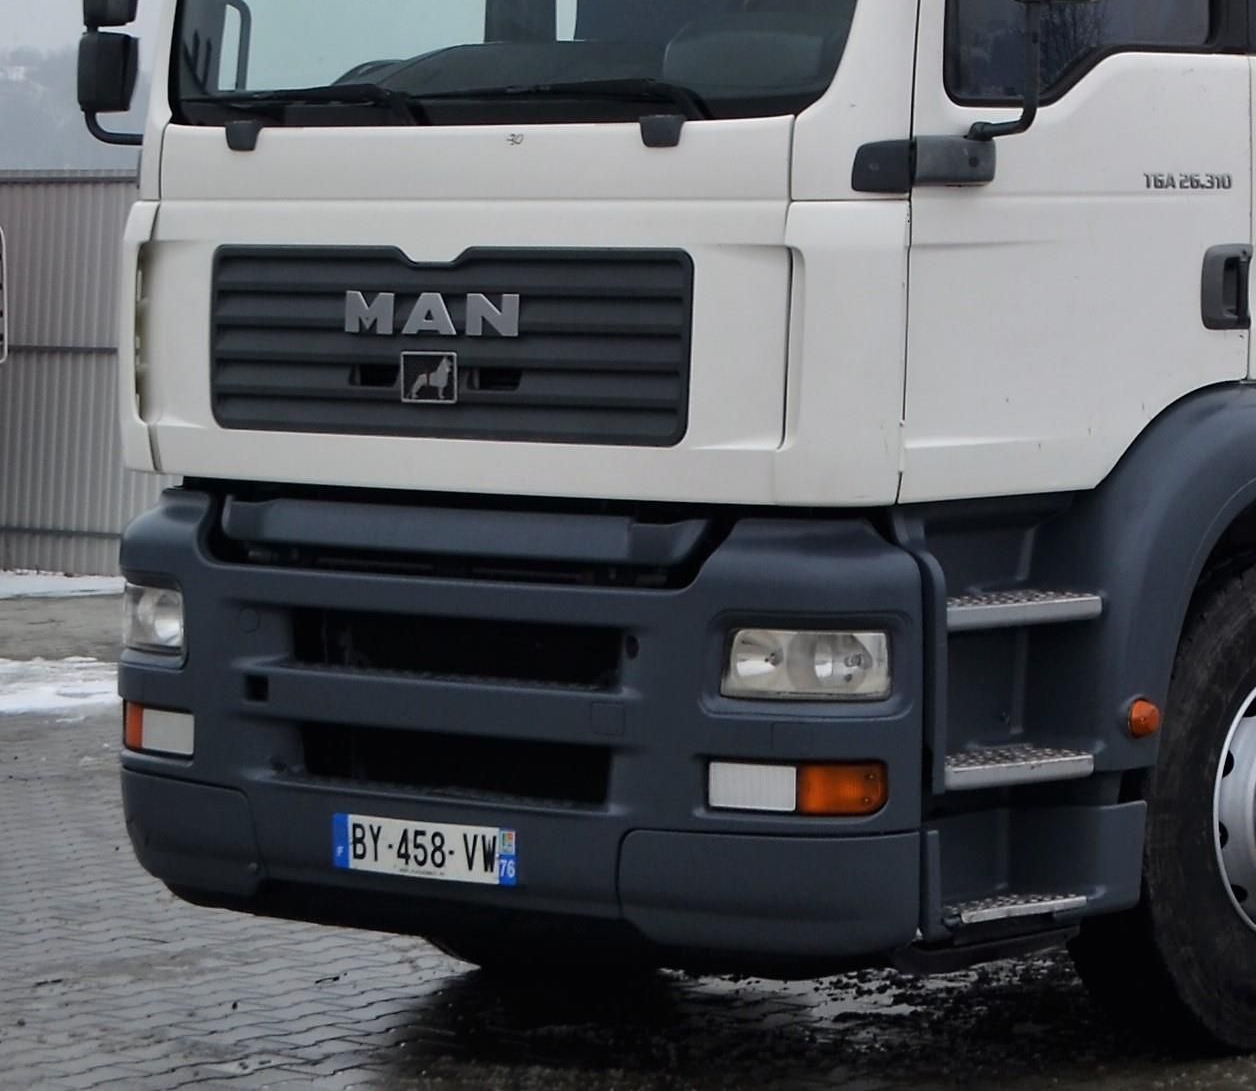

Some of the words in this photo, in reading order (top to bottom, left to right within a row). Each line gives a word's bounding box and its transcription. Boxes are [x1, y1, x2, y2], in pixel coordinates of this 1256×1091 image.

[1143, 172, 1176, 189] TGA
[1179, 173, 1232, 190] 26.310
[344, 289, 520, 338] MAN
[336, 846, 345, 858] F
[499, 859, 516, 878] 76
